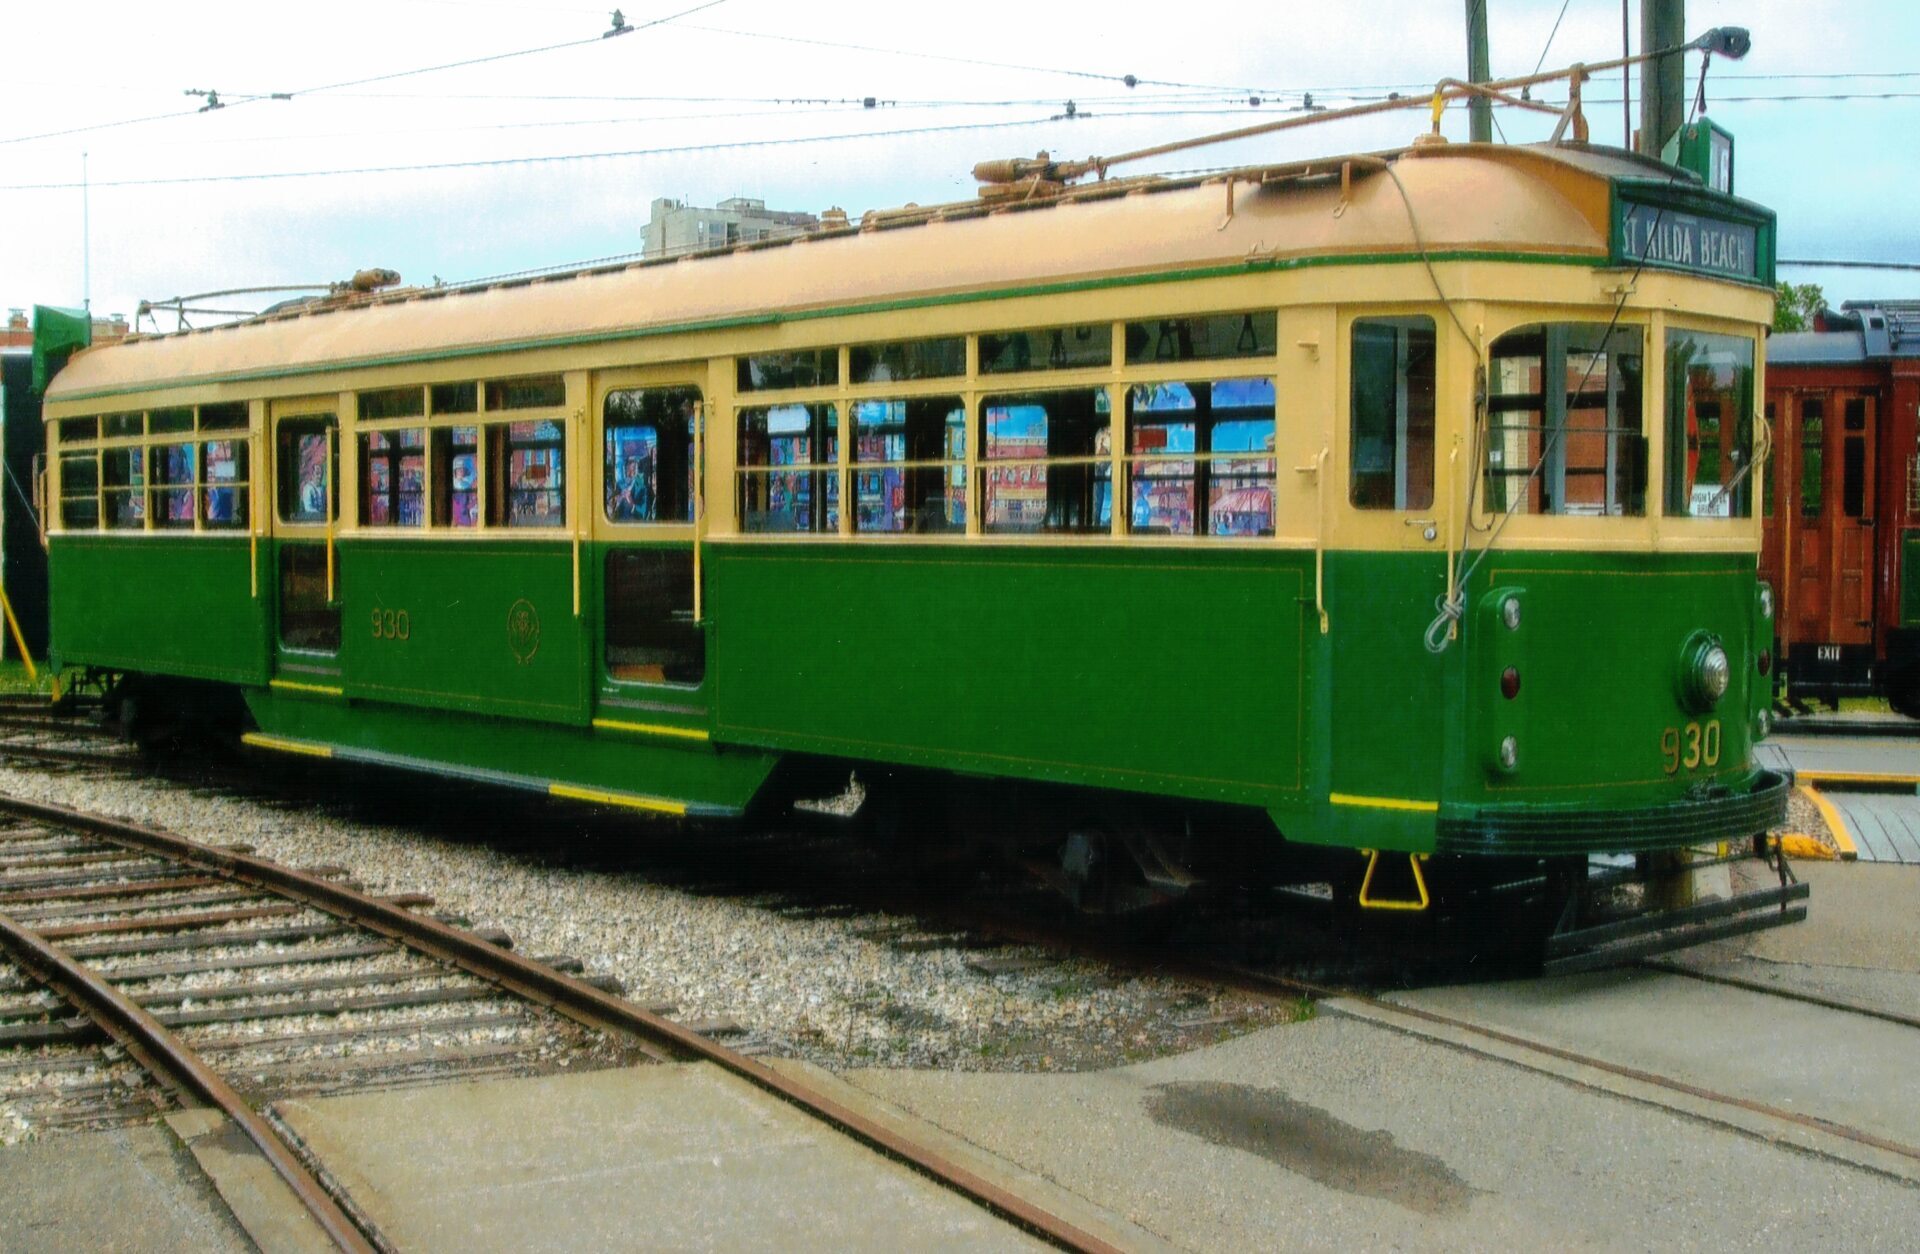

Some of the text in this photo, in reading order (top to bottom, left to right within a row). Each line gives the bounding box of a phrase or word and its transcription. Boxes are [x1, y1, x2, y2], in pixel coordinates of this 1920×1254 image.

[1646, 218, 1692, 265] KILDA
[1701, 230, 1746, 271] BEACH
[371, 607, 409, 640] 930
[1817, 646, 1841, 661] EXIT
[1661, 719, 1720, 774] 930
